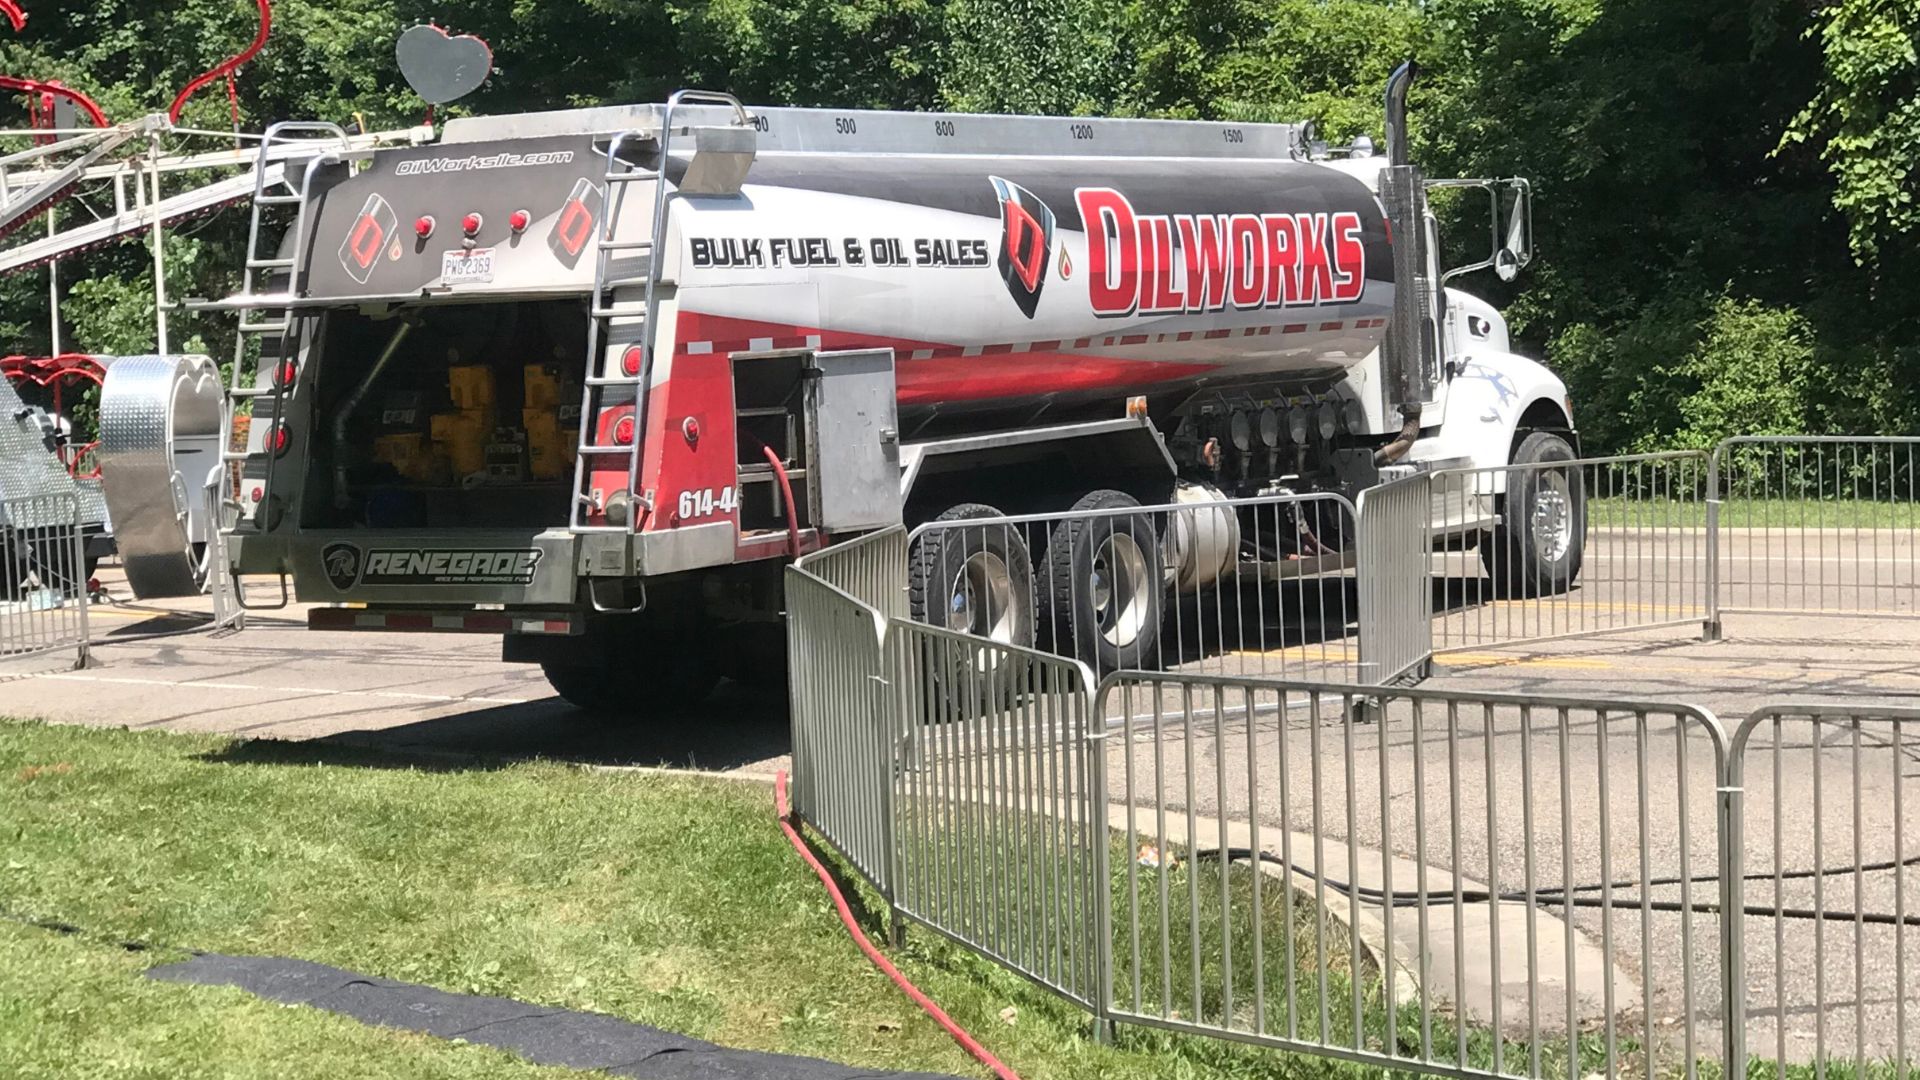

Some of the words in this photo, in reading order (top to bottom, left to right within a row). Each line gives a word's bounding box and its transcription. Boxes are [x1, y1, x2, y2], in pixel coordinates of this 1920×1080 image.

[754, 115, 769, 132] 00
[835, 117, 857, 135] 500
[934, 120, 955, 137] 800
[1070, 124, 1094, 140] 1200
[1222, 128, 1244, 143] 1500
[689, 238, 766, 268] BULK
[768, 238, 840, 268] FUEL
[844, 238, 866, 267] &
[869, 238, 910, 268] OIL
[914, 239, 991, 268] SALES
[1074, 187, 1366, 318] OILWORKS
[366, 552, 540, 575] RENEGADE
